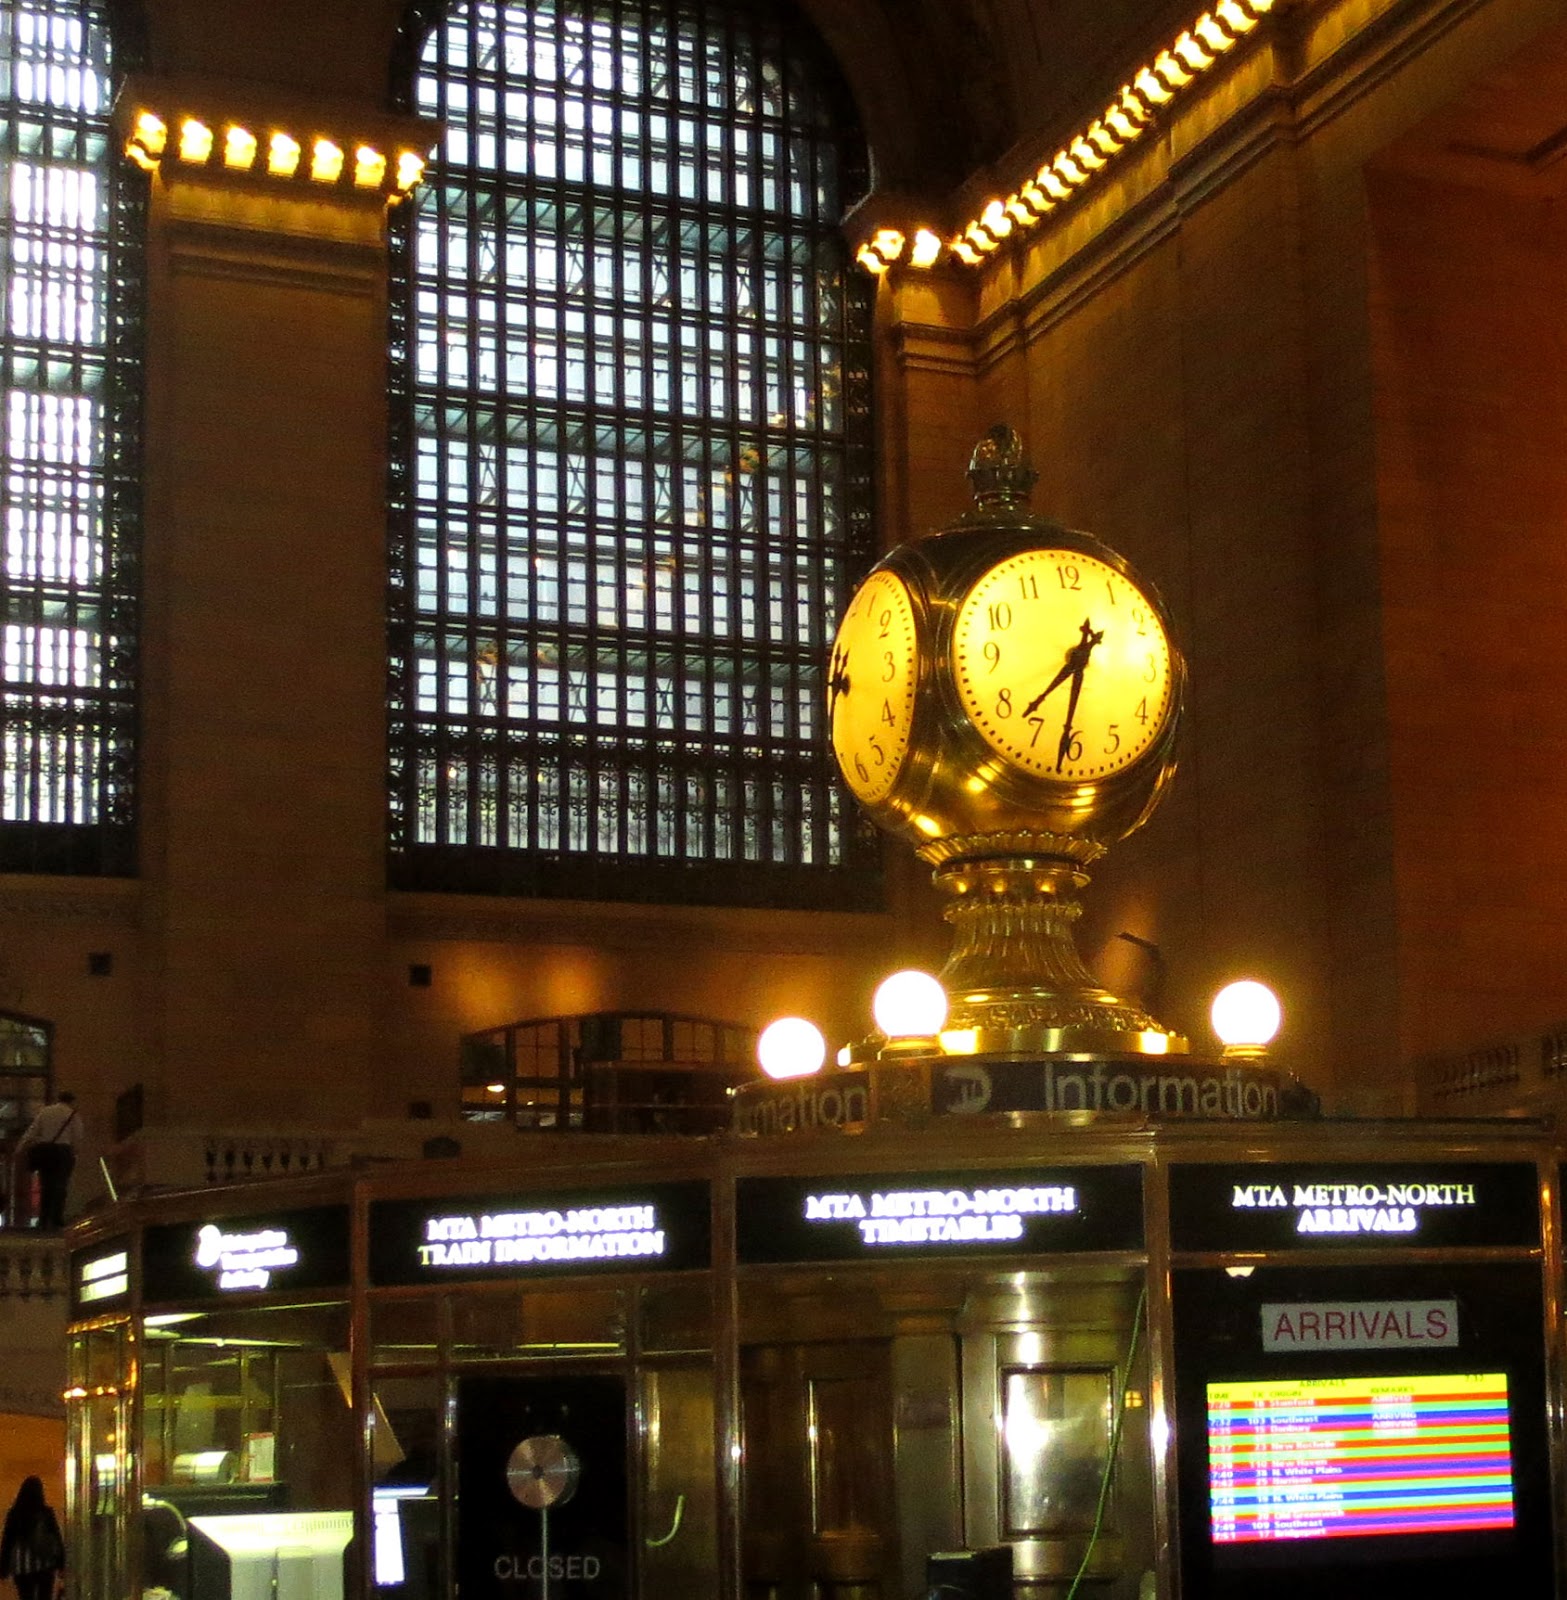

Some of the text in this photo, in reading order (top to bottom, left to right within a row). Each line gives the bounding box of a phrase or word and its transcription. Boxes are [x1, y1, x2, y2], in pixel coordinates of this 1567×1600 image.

[1019, 574, 1039, 600] 11
[1056, 565, 1082, 591] 12
[1106, 580, 1116, 605] 1
[879, 610, 892, 639] 2
[988, 602, 1012, 631] 10
[882, 651, 896, 683] 3
[983, 642, 1000, 674] 9
[1143, 653, 1157, 683] 3
[882, 698, 896, 727] 4
[995, 688, 1012, 719] 8
[1134, 696, 1149, 725] 4
[1028, 717, 1045, 748] 7
[1066, 730, 1083, 761] 6
[1104, 725, 1120, 754] 5
[869, 735, 884, 766] 5
[854, 752, 869, 783] 6
[1045, 1061, 1278, 1118] Information
[805, 1187, 1075, 1218] MTA METRO-NORTH
[1232, 1184, 1474, 1206] MTA METRO-NORTH
[427, 1206, 654, 1240] MTA METRO-NORTH
[859, 1214, 1023, 1243] TIMETABLES
[1297, 1208, 1417, 1232] ARRIVALS
[418, 1231, 665, 1265] TRAIN INFORMATION
[1274, 1310, 1448, 1341] ARRIVALS
[1270, 1416, 1319, 1425] Southeast
[1372, 1412, 1417, 1420] ARRIVING
[1271, 1460, 1295, 1468] New
[1285, 1468, 1314, 1476] White
[1315, 1466, 1343, 1475] Plains
[1286, 1493, 1315, 1501] White
[1316, 1491, 1344, 1500] Plains
[1252, 1521, 1270, 1529] 109
[1274, 1519, 1324, 1529] Southeast
[494, 1556, 600, 1579] CLOSED
